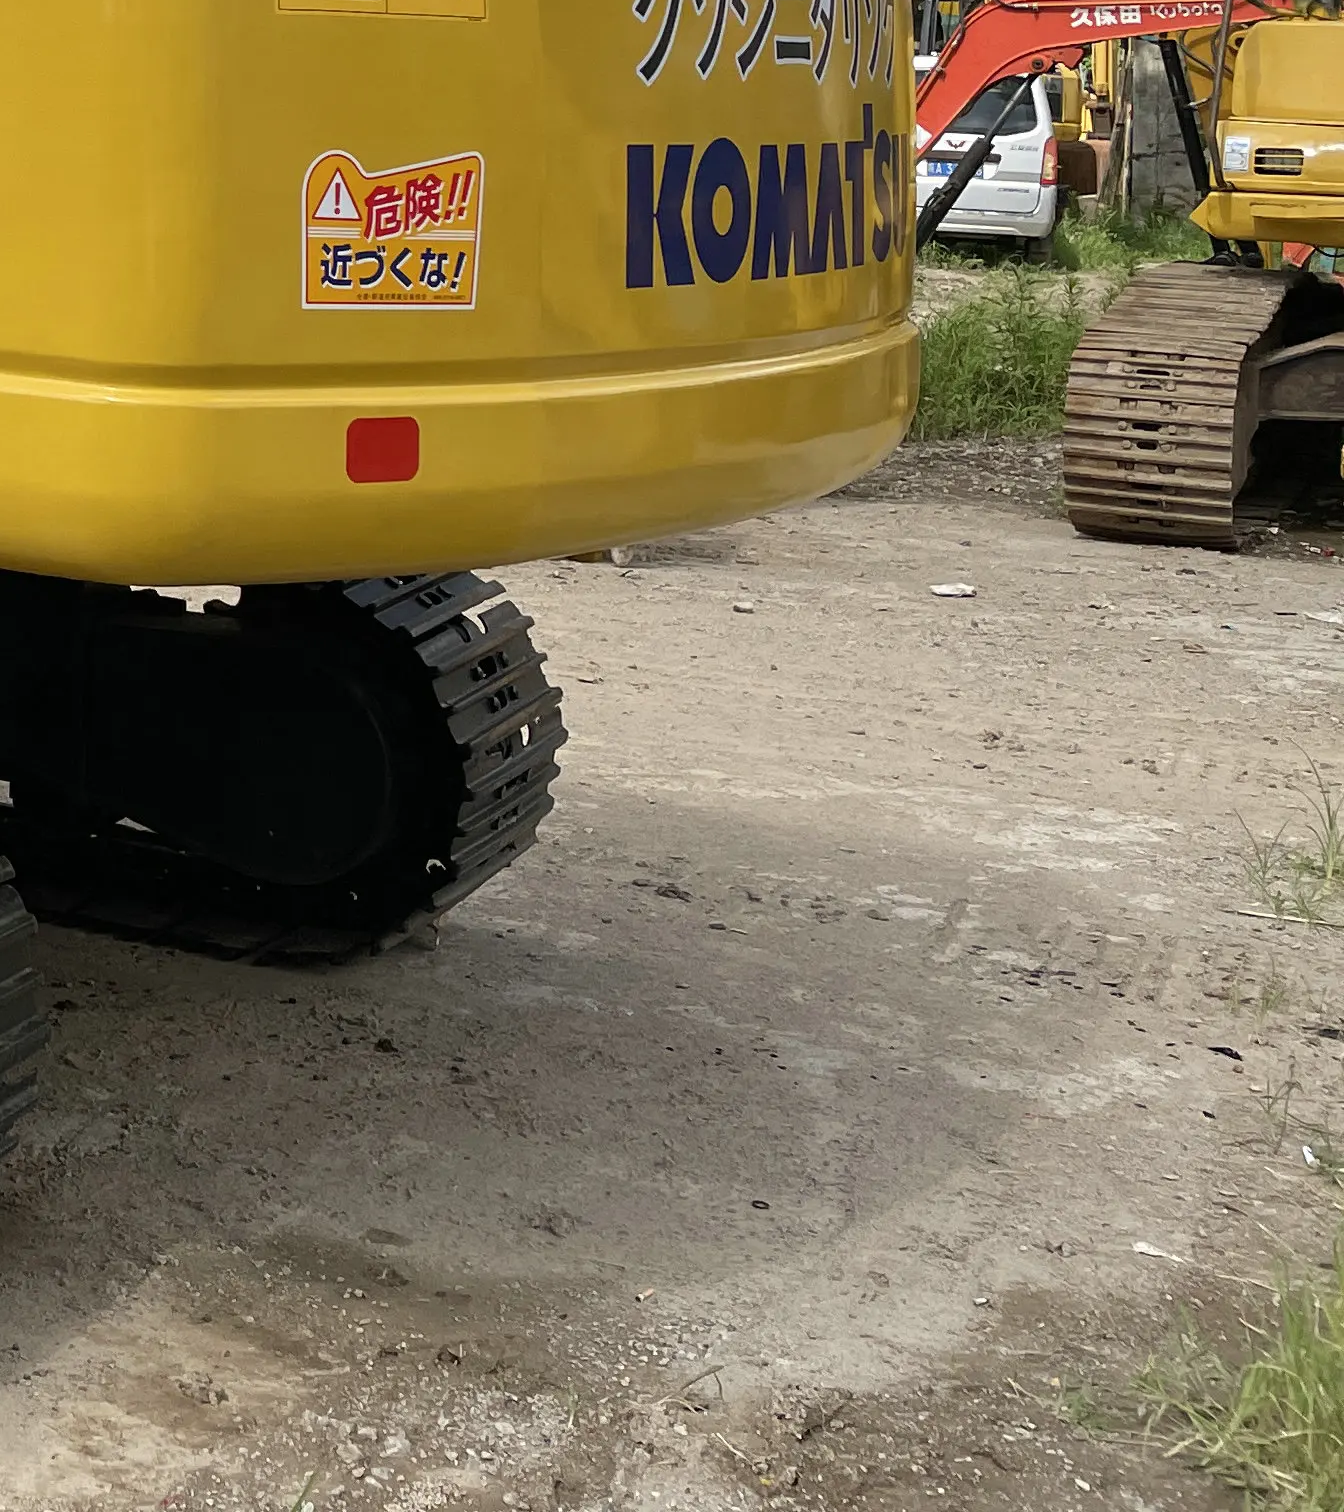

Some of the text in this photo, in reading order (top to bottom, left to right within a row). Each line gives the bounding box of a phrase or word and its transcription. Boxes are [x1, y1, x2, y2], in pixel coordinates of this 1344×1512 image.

[1070, 5, 1142, 28] 久保田
[1150, 2, 1224, 19] Kubota
[626, 103, 909, 288] KOMATSU
